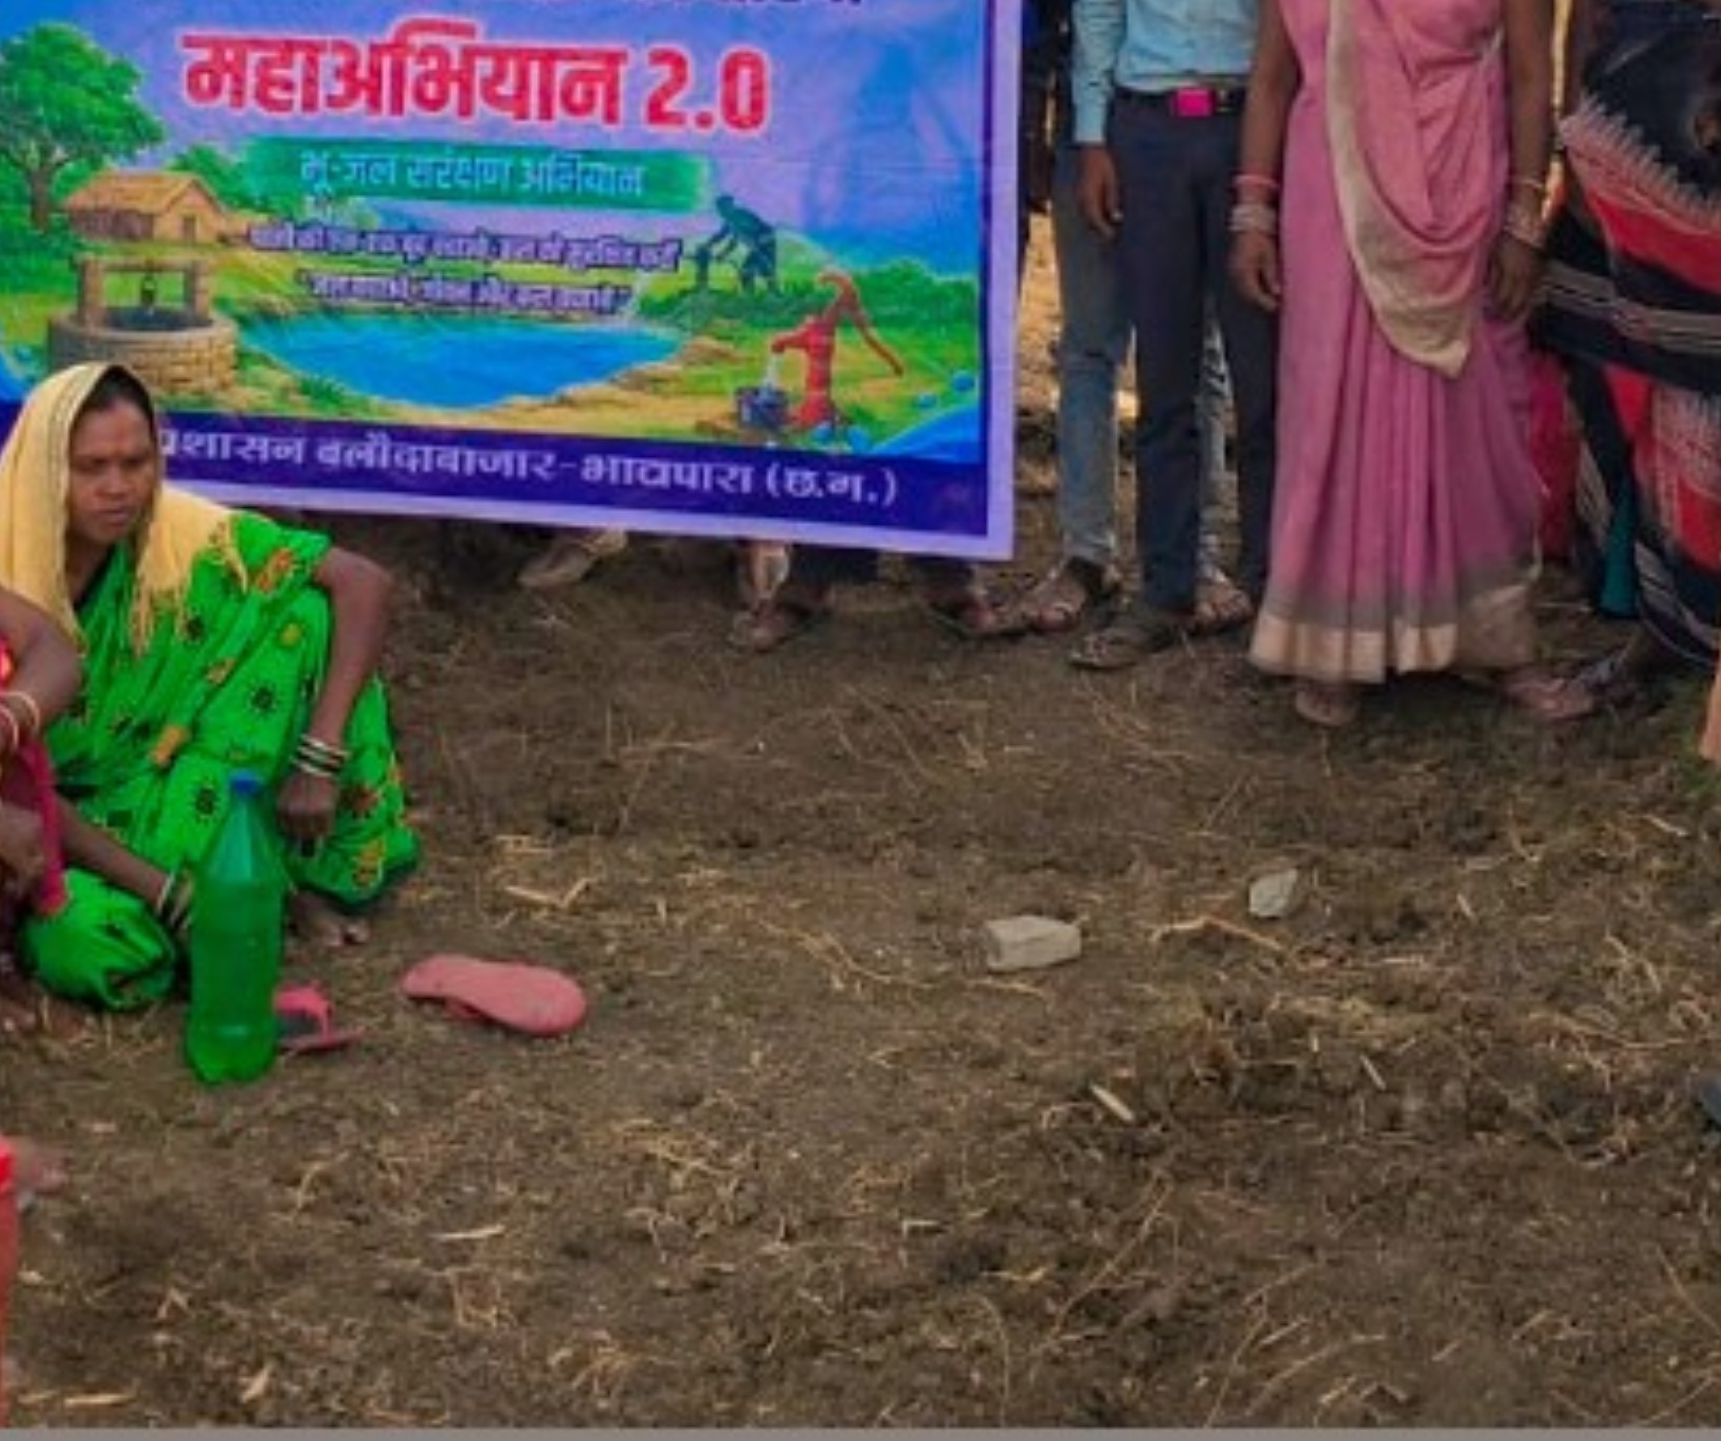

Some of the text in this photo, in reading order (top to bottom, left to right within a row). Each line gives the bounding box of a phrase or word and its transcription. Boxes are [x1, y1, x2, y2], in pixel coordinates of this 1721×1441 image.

[182, 18, 768, 132] महाअभियान 2.0
[521, 148, 648, 198] अभियान
